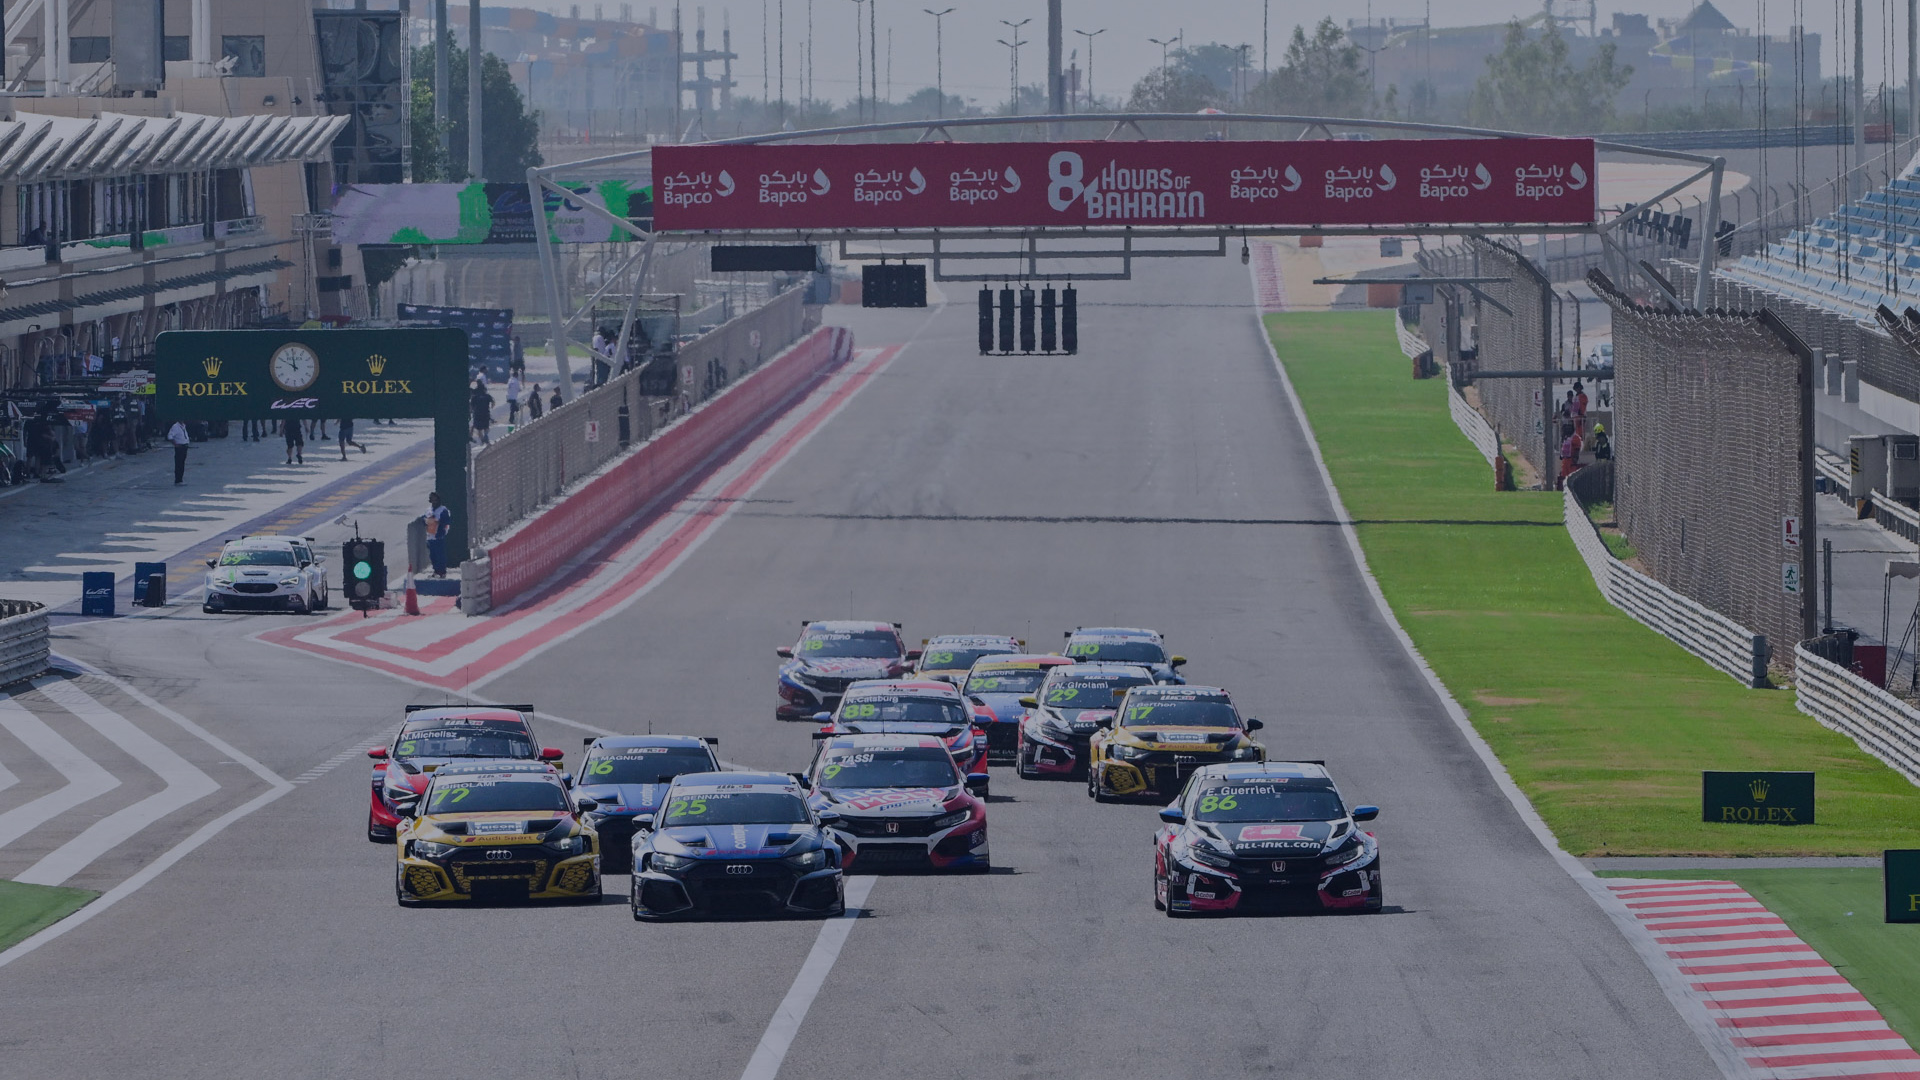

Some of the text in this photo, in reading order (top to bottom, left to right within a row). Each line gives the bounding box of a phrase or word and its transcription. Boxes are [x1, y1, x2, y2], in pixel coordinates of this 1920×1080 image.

[664, 172, 712, 188] بابكو
[760, 171, 807, 187] بابكو
[855, 169, 903, 186] بابكو
[950, 169, 998, 185] بابكو
[1231, 167, 1278, 183] بابكو
[1326, 166, 1373, 183] بابكو
[1421, 165, 1468, 181] بابكو
[1516, 164, 1564, 181] بابكو
[1047, 150, 1191, 212] 8 HOURS OF
[664, 190, 712, 208] Bapco
[760, 189, 807, 206] Bapco
[855, 188, 903, 205] Bapco
[950, 187, 998, 204] Bapco
[1231, 185, 1278, 202] Bapco
[1326, 185, 1373, 202] Bapco
[1421, 183, 1468, 201] Bapco
[1516, 183, 1564, 200] Bapco
[1086, 191, 1205, 219] BAHRAIN
[178, 382, 248, 396] ROLEX
[342, 380, 413, 394] ROLEX
[270, 397, 319, 410] WEC
[970, 676, 998, 690] 96
[1068, 681, 1109, 690] Girolami
[1048, 688, 1079, 702] 29
[844, 704, 875, 718] 88
[1128, 706, 1154, 720] 17
[398, 740, 416, 756] 5
[841, 754, 874, 764] TASSI
[449, 765, 542, 774] TRICORP
[588, 760, 614, 775] 16
[824, 764, 842, 780] 9
[1206, 785, 1276, 796] E. Guerrieri
[852, 790, 937, 808] MOLY
[1200, 795, 1238, 814] 86
[668, 800, 707, 818] 25
[1721, 806, 1797, 822] ROLEX
